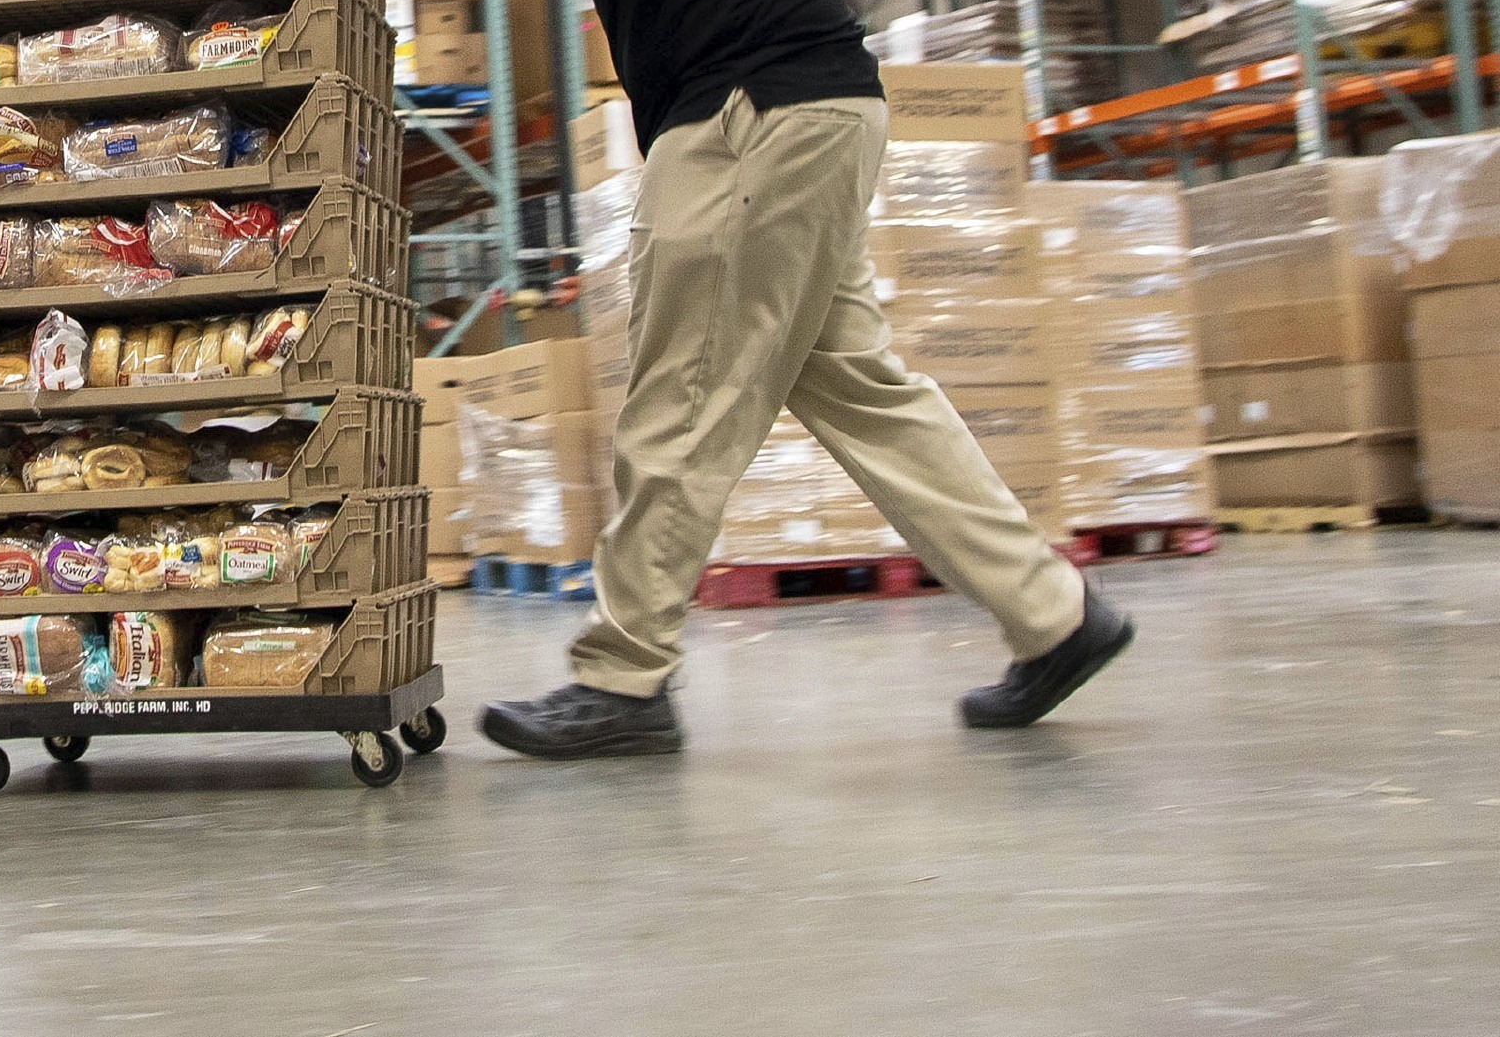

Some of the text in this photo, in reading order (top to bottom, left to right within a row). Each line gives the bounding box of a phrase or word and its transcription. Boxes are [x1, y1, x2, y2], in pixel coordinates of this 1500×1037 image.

[202, 37, 259, 57] FARMHOUSE
[59, 561, 92, 579] Swirl
[228, 557, 268, 570] Oatmeal
[129, 624, 147, 683] Italian
[73, 701, 135, 714] PEPPRIDGE
[196, 700, 211, 713] HD
